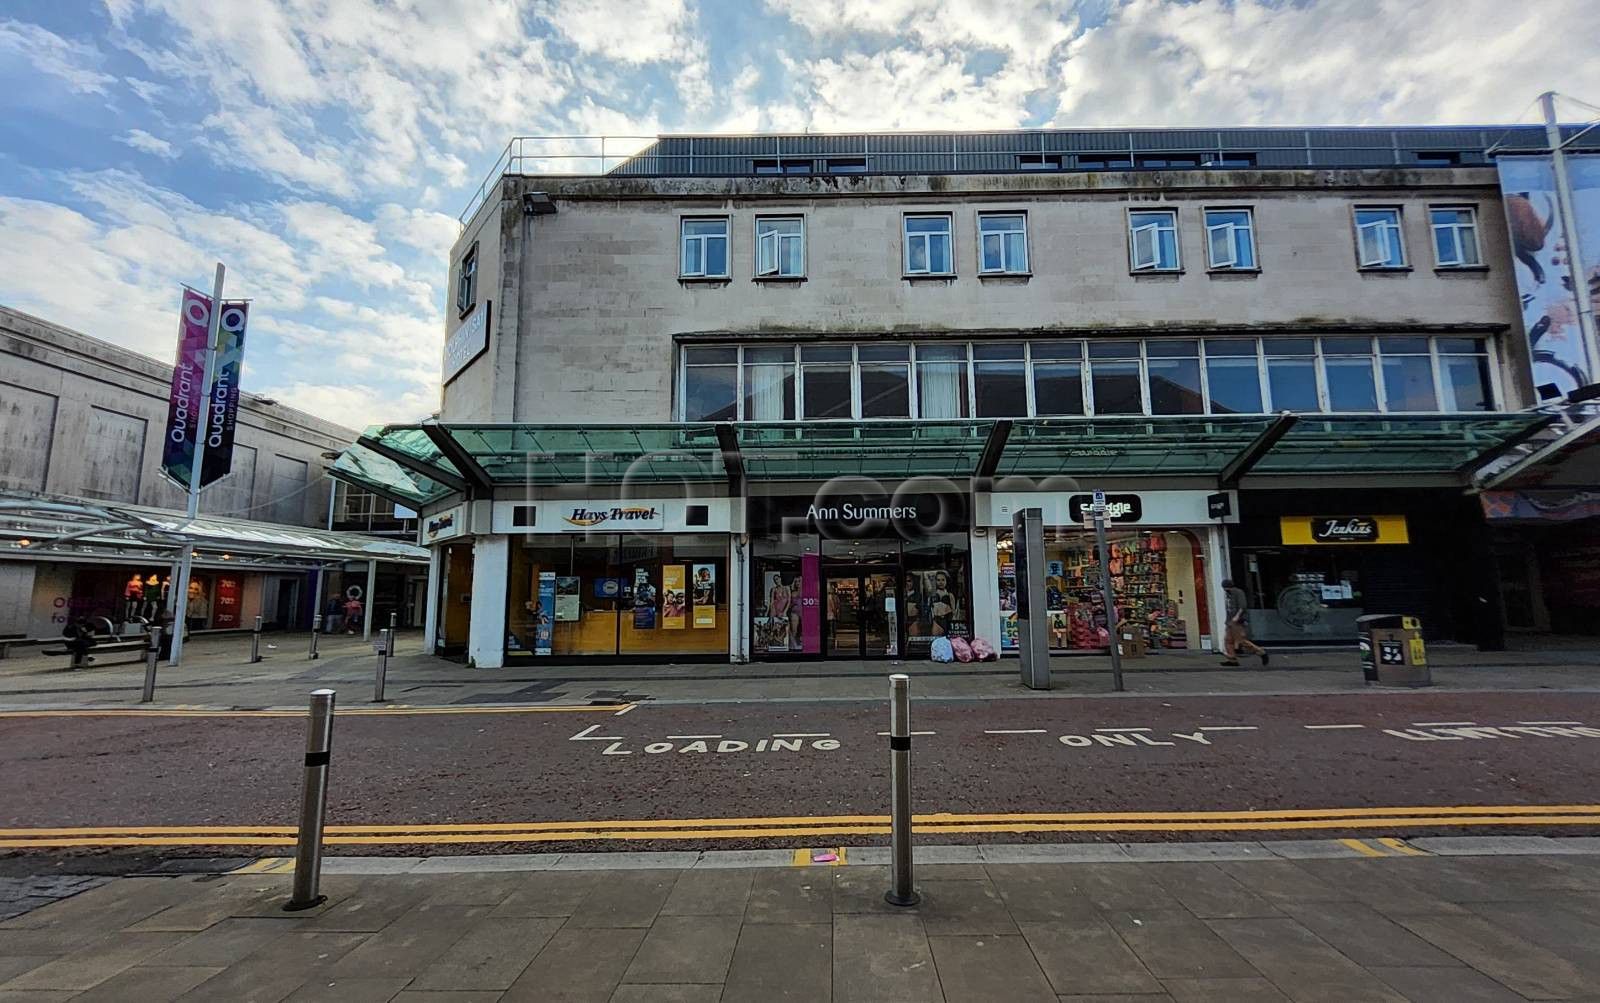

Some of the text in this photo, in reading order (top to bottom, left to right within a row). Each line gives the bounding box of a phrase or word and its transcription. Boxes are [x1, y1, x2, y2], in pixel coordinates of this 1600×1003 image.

[171, 362, 193, 443] Quadrant
[208, 371, 230, 448] Quadrant
[570, 507, 656, 524] Hays Travel
[805, 503, 917, 520] Ann Summers
[1319, 518, 1372, 538] Jenkins
[602, 732, 1212, 755] LOADING ONLY
